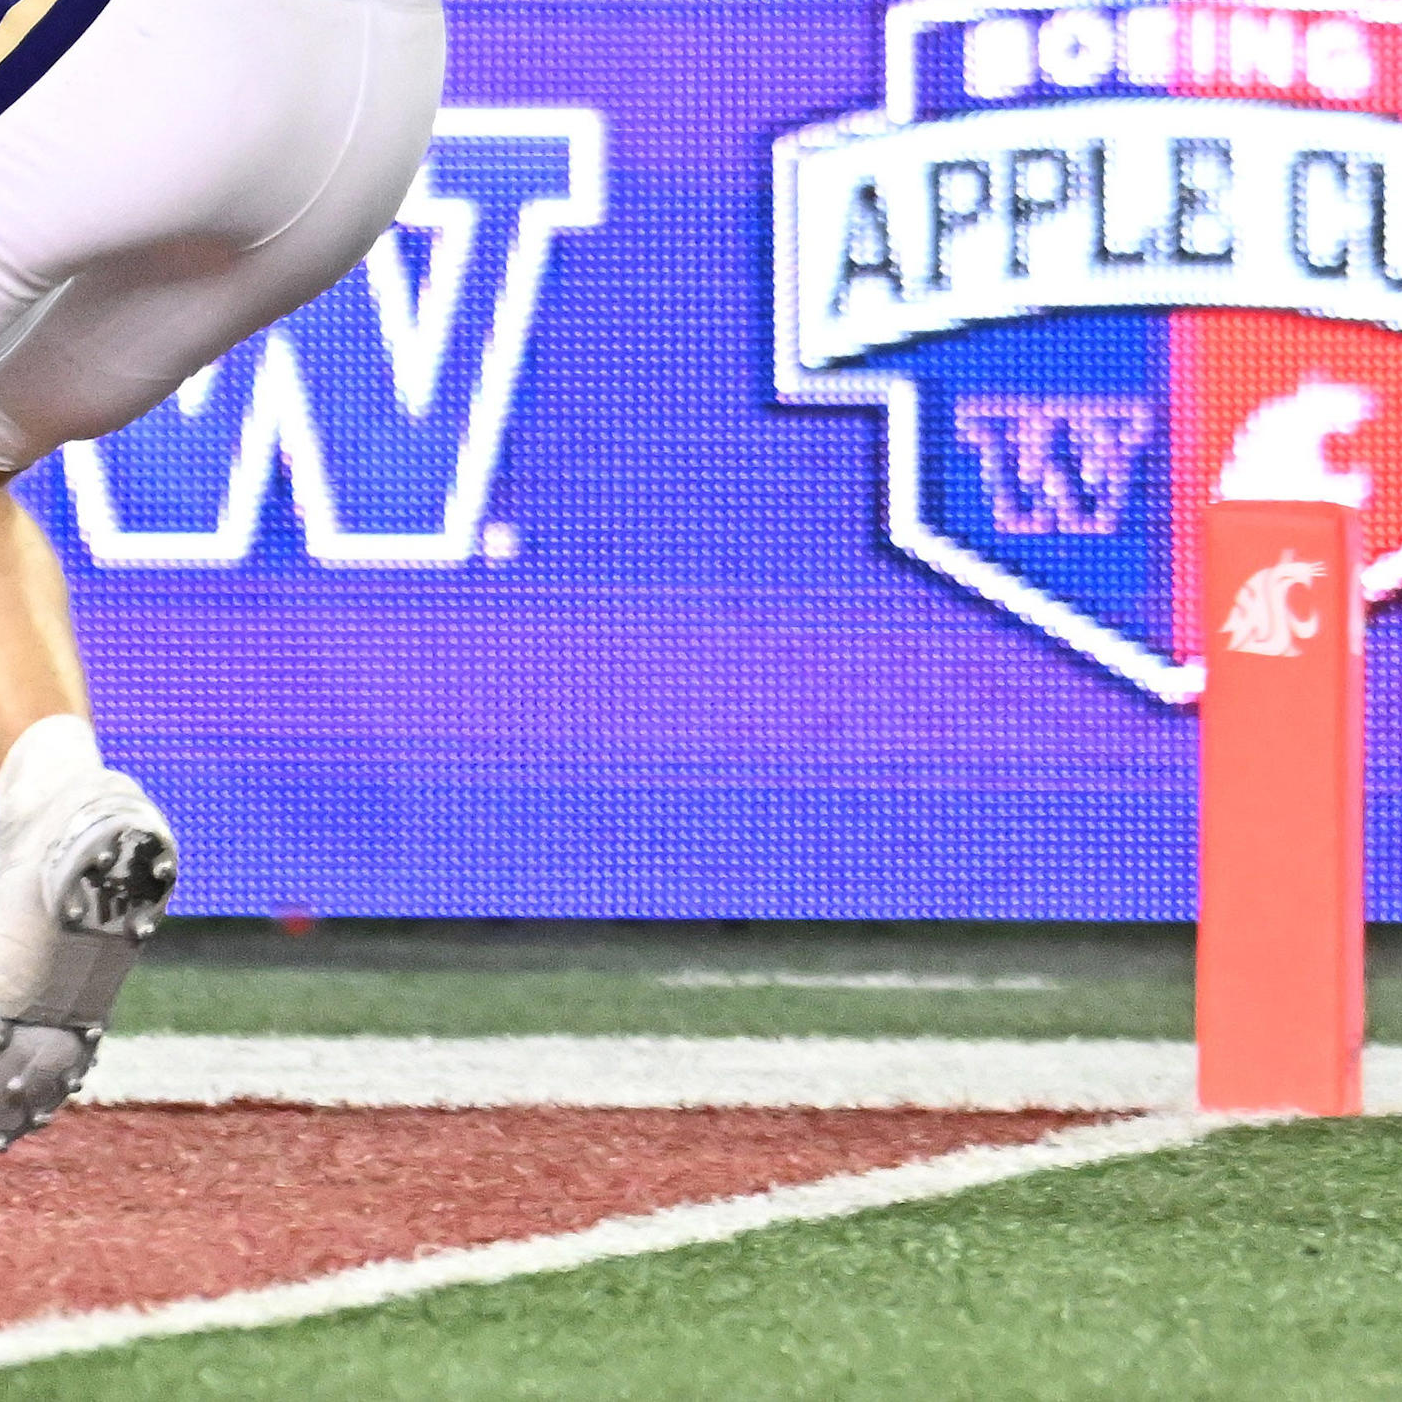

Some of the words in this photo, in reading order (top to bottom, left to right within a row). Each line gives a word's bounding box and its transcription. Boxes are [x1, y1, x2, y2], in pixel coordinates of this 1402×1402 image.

[962, 6, 1373, 100] BOEING
[828, 135, 1236, 316] APPLE
[954, 396, 1153, 536] W
